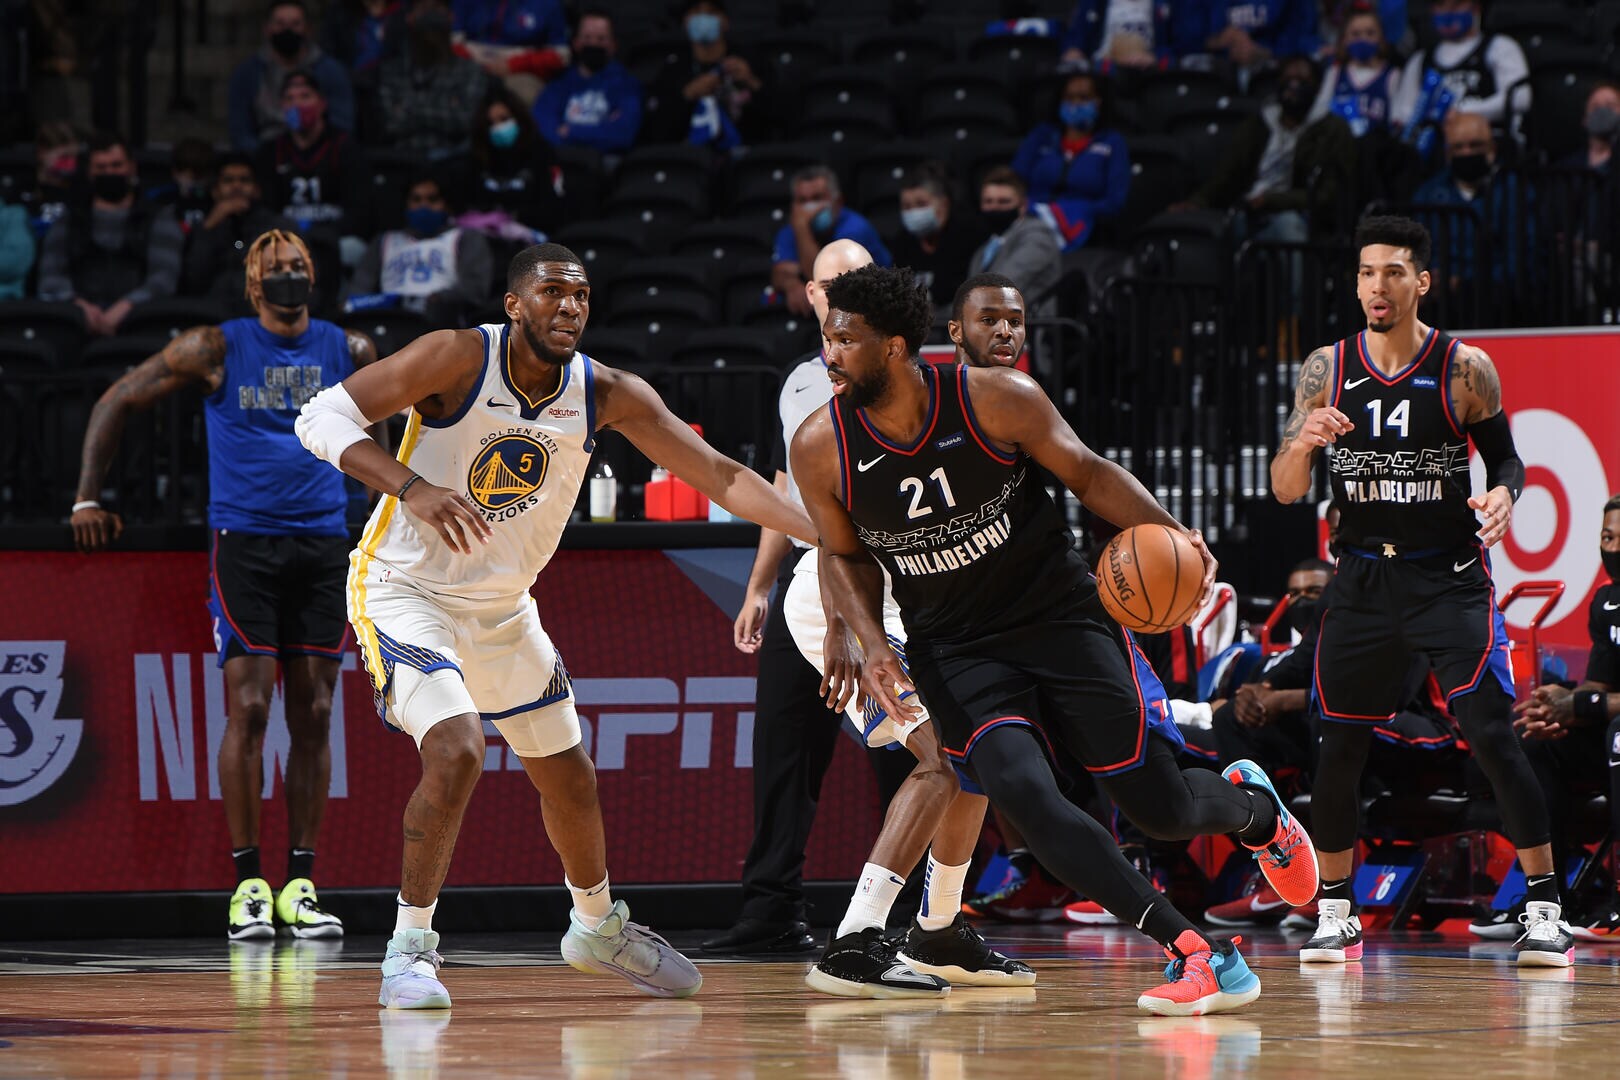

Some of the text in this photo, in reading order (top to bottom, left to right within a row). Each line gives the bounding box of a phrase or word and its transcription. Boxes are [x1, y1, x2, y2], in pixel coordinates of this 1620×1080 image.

[548, 408, 580, 417] Rakuten
[1366, 399, 1410, 437] 14
[480, 427, 559, 456] GOLDEN STATE
[938, 436, 962, 448] StubHub
[519, 453, 536, 473] 5
[464, 491, 539, 523] RIORS
[900, 466, 956, 520] 21
[894, 512, 1012, 576] PHILADELPHIA
[483, 676, 757, 772] PN
